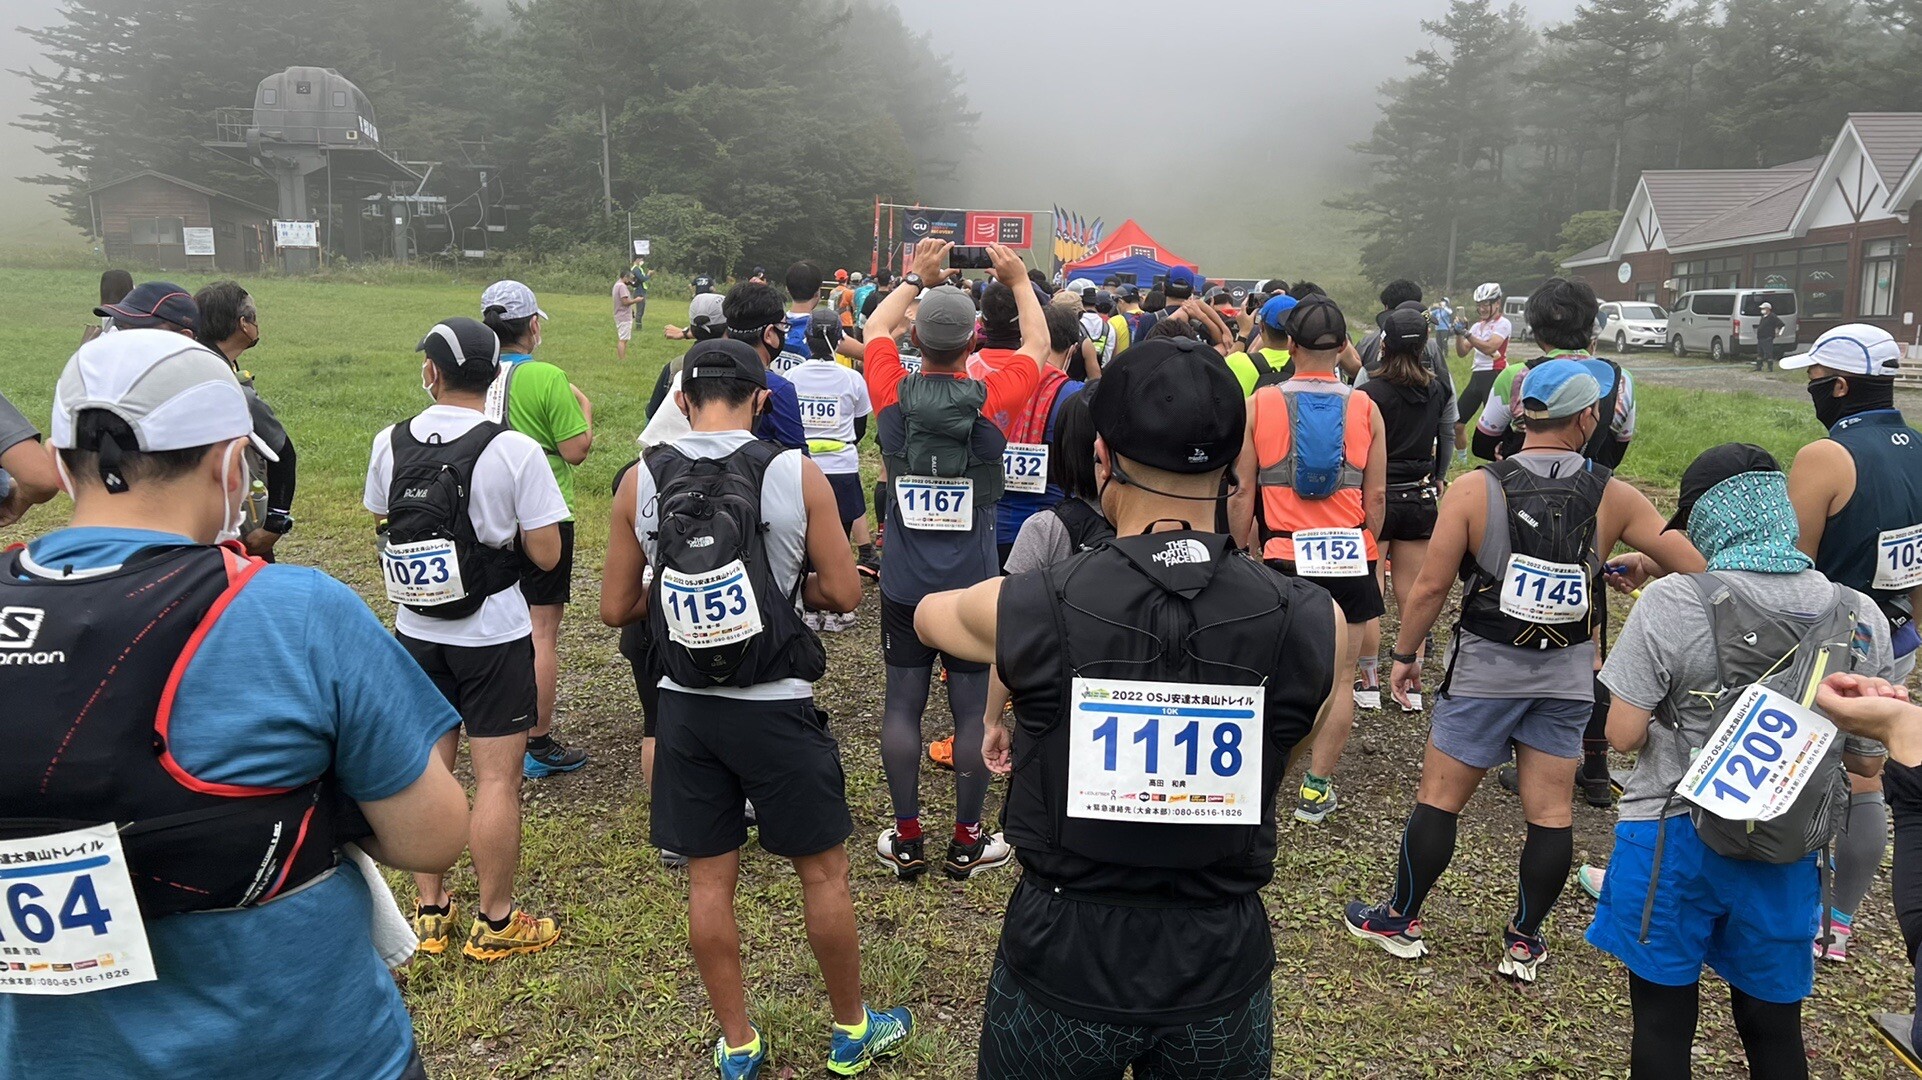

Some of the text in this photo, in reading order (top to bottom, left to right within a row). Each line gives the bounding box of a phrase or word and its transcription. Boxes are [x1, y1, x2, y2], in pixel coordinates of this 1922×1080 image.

[800, 402, 836, 418] 1196
[1004, 455, 1041, 477] 132
[904, 489, 965, 512] 1167
[1152, 548, 1188, 562] NORTH
[1165, 540, 1187, 550] THE
[1302, 541, 1359, 560] 1152
[386, 557, 449, 585] 1023
[1165, 556, 1190, 568] FACE
[1527, 561, 1541, 569] 2022
[1515, 572, 1582, 606] 1145
[668, 584, 747, 624] 1153
[1112, 691, 1143, 701] 2022
[1146, 692, 1255, 706] OSJ安達太良山トレイル
[1092, 716, 1243, 777] 1118
[1712, 708, 1798, 804] 1209
[1698, 755, 1715, 775] 2022
[0, 874, 113, 943] 64
